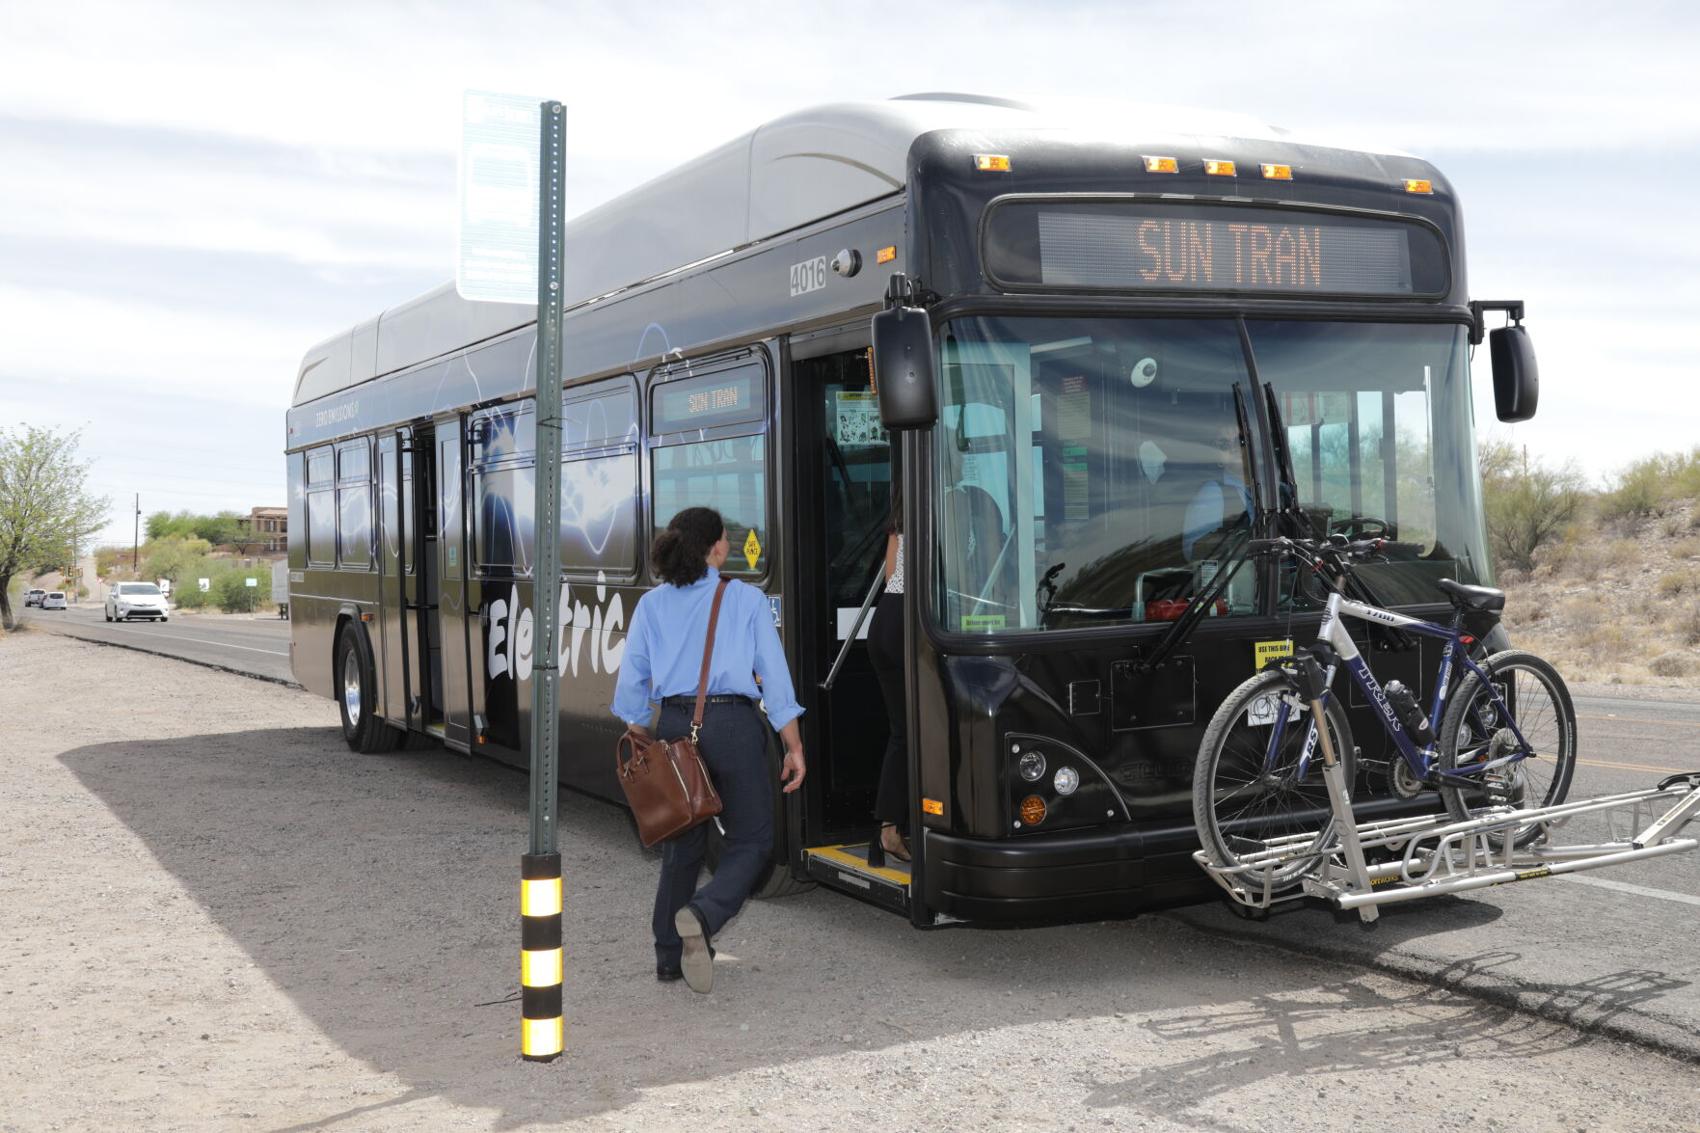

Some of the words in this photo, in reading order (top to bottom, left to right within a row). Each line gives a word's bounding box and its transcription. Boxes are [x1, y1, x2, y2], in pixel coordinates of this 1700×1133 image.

[791, 257, 825, 294] 4016
[1137, 219, 1213, 282] SUN
[1227, 224, 1321, 287] TRAN
[688, 391, 708, 413] SUN
[711, 386, 737, 409] TRAN
[488, 570, 626, 680] Eletric
[1358, 661, 1402, 731] TREK
